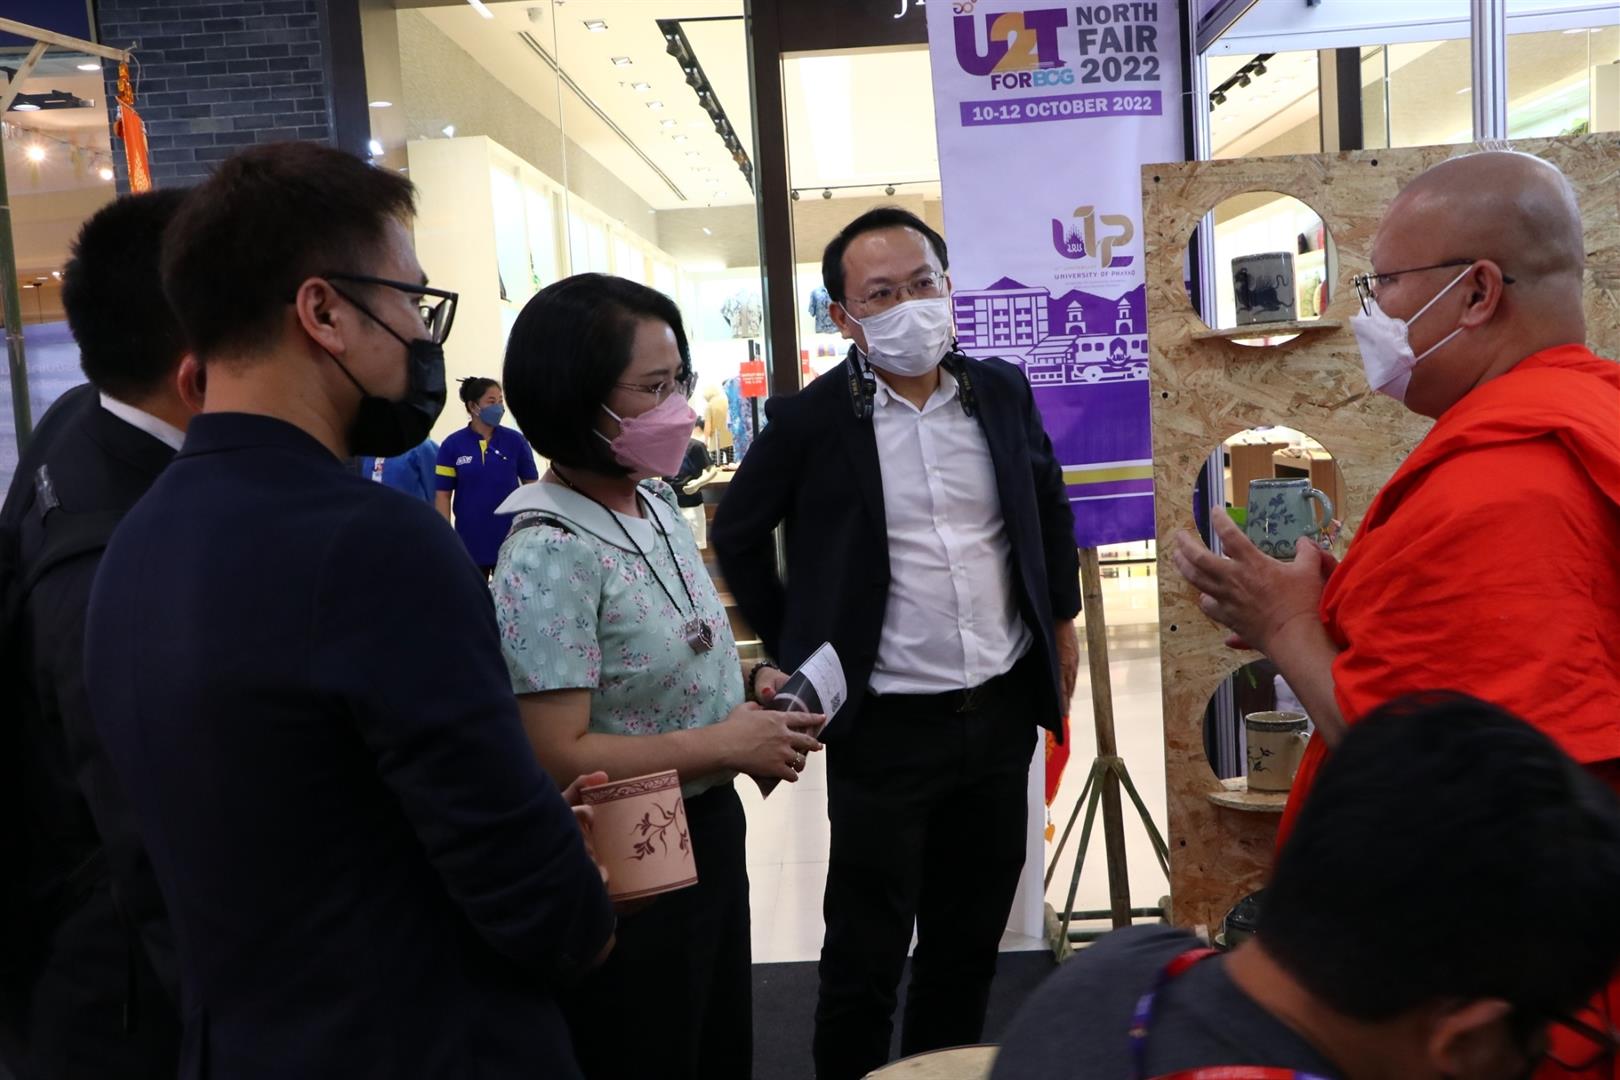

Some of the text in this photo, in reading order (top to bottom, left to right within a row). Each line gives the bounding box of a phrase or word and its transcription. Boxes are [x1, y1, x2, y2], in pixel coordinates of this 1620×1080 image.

[1076, 3, 1158, 26] NORTH
[1078, 25, 1158, 56] FAIR
[1080, 56, 1161, 84] 2022
[973, 96, 1152, 121] 10-12 OCTOBER 2022
[1054, 271, 1098, 280] UNIVERSITY
